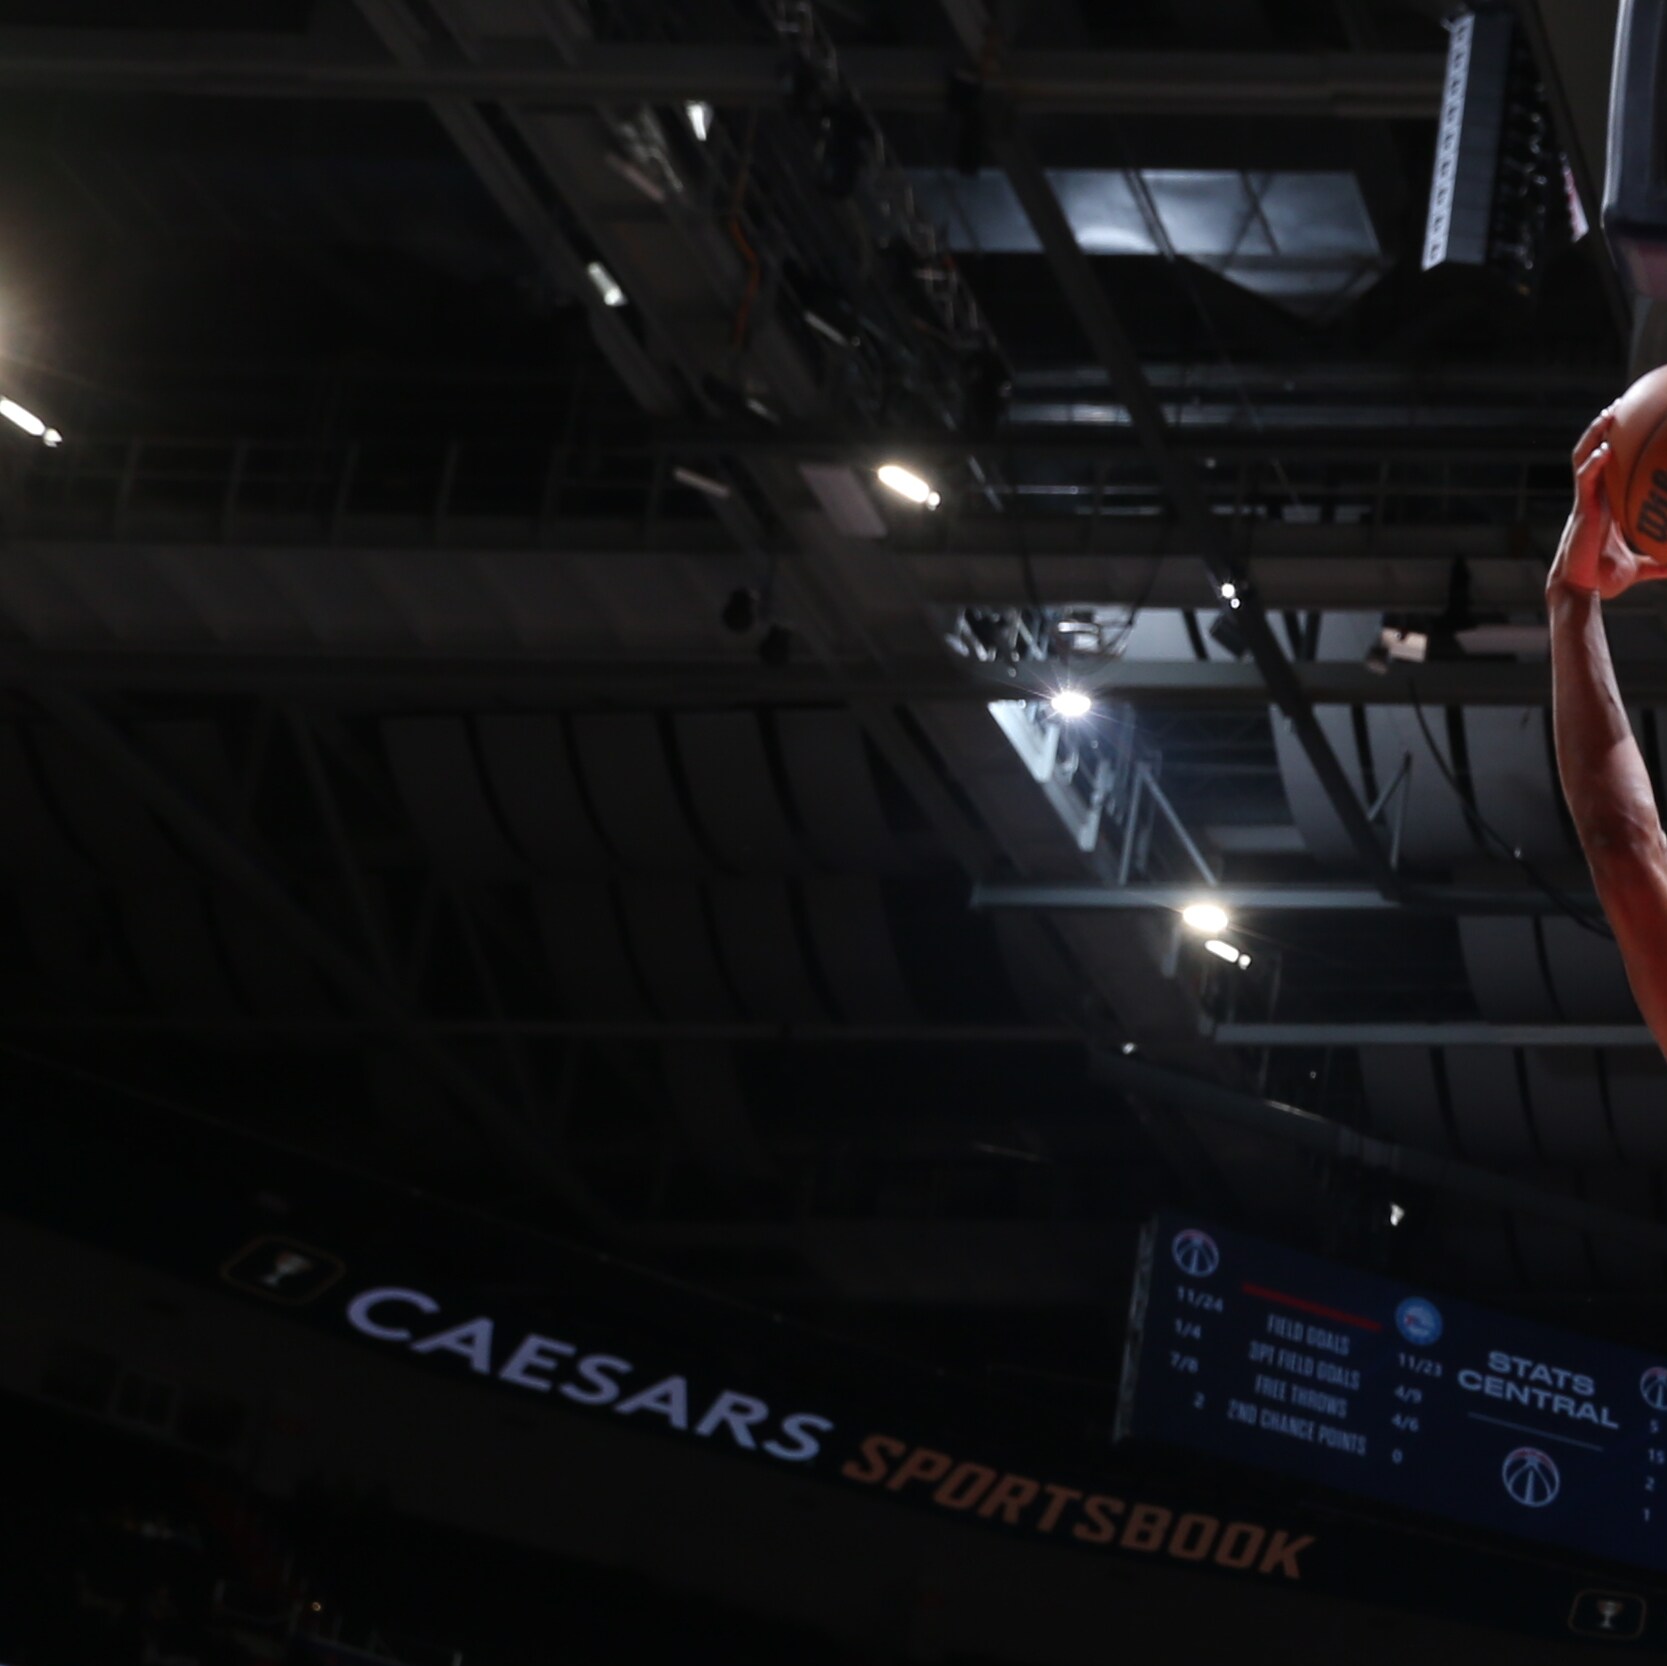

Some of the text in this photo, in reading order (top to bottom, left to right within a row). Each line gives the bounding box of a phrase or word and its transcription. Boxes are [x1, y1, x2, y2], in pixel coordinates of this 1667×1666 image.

[1266, 1312, 1350, 1356] FIELD GOALS
[1255, 1373, 1348, 1419] FREE THROWS
[1487, 1350, 1596, 1396] STATS
[1457, 1368, 1620, 1430] CENTRAL
[347, 1287, 1320, 1580] CAESARS SPORTSBOOK
[1259, 1408, 1316, 1445] CHANCE
[1317, 1425, 1367, 1456] POINTS
